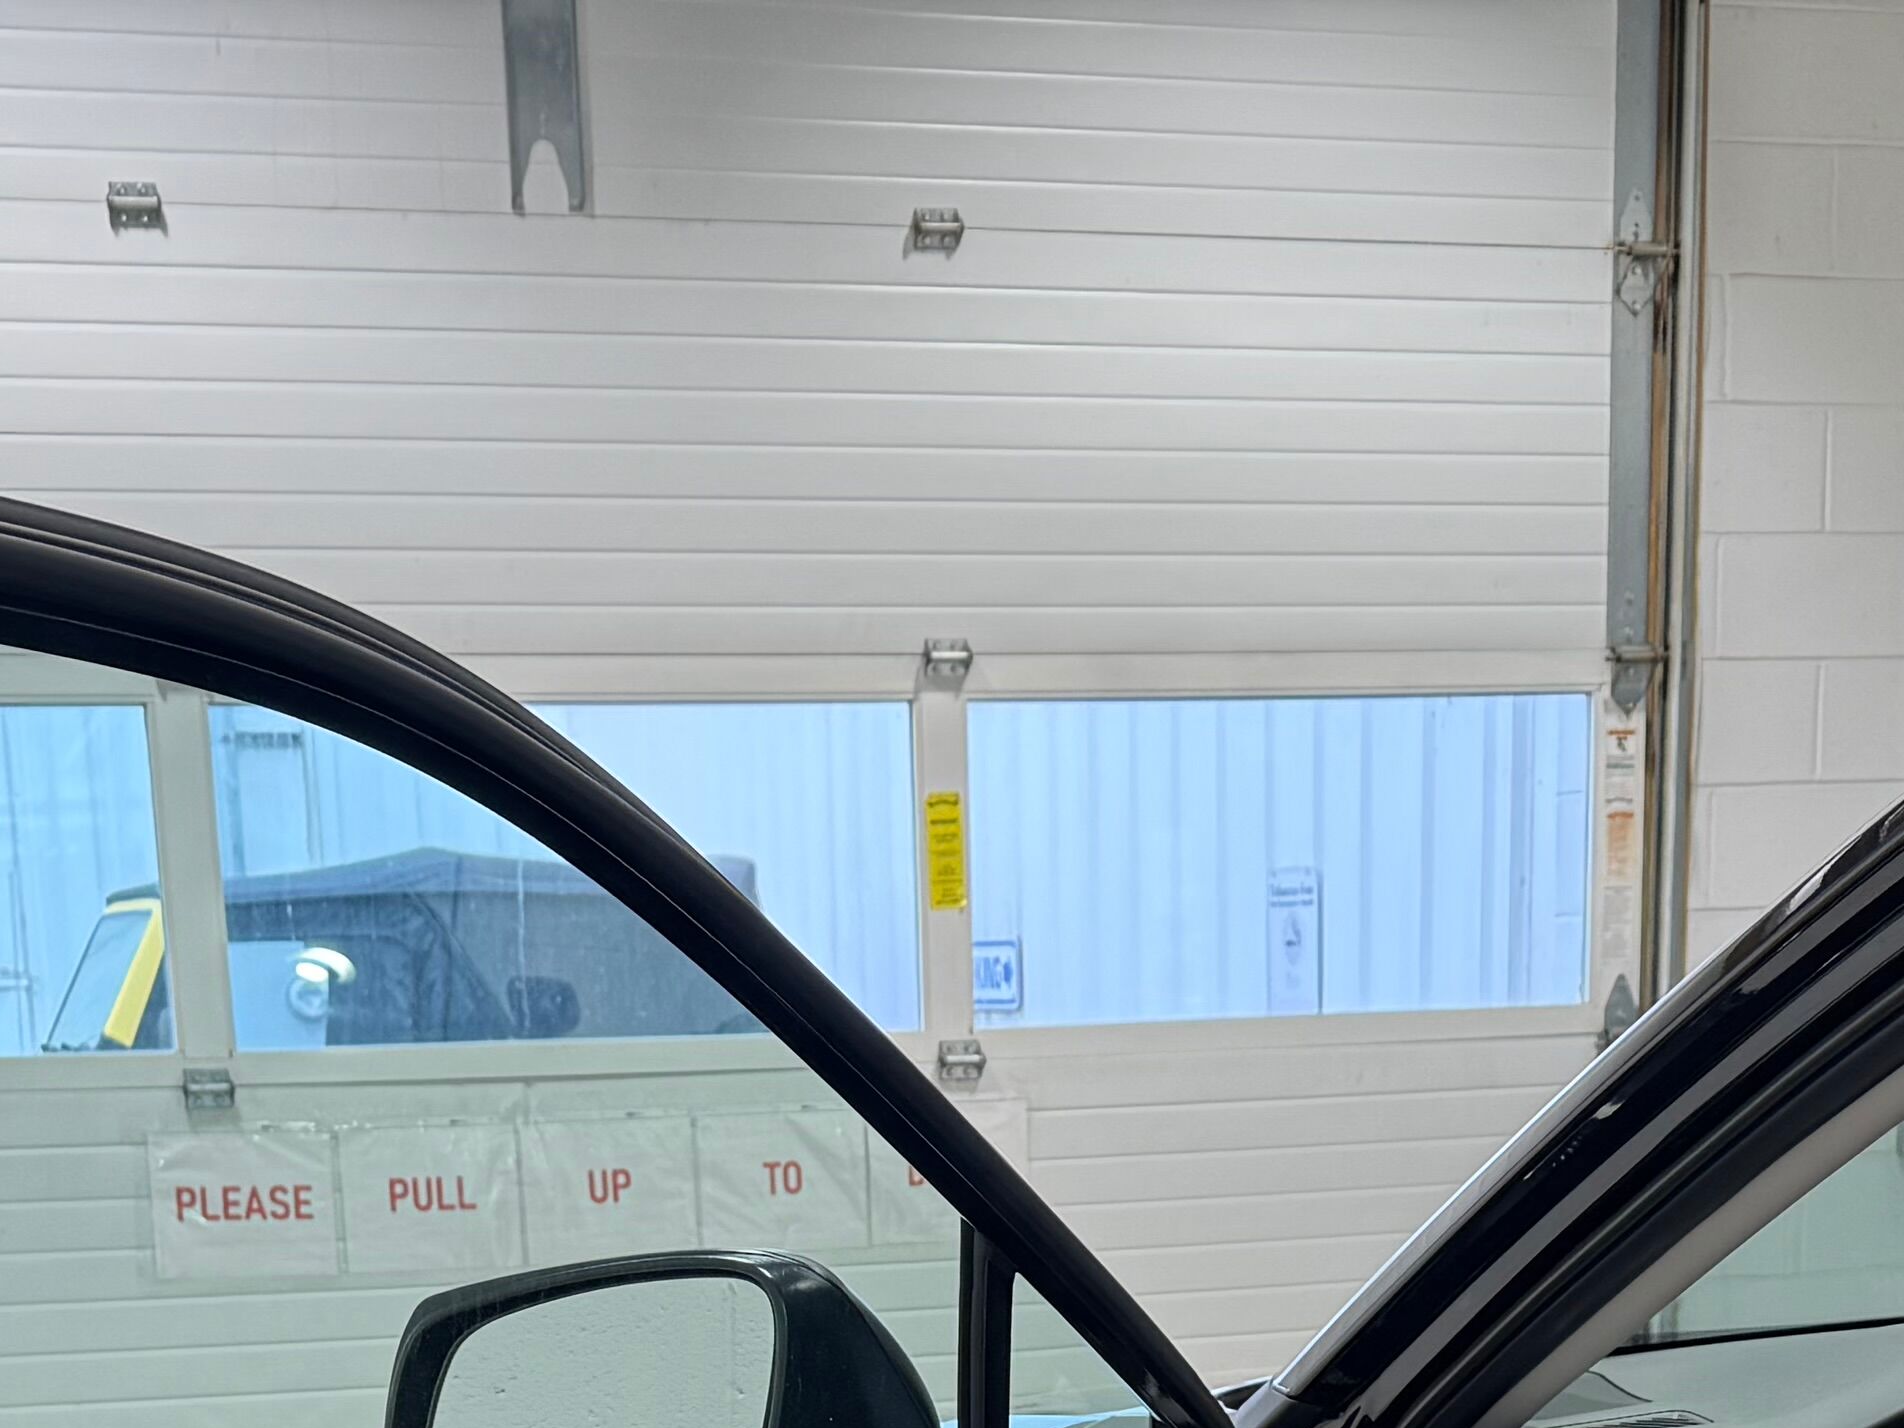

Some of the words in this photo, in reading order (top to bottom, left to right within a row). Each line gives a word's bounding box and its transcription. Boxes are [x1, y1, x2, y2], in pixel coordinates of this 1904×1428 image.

[175, 1185, 315, 1223] PLEASE
[388, 1176, 478, 1214] PULL
[587, 1168, 633, 1205] UP
[762, 1161, 803, 1197] TO
